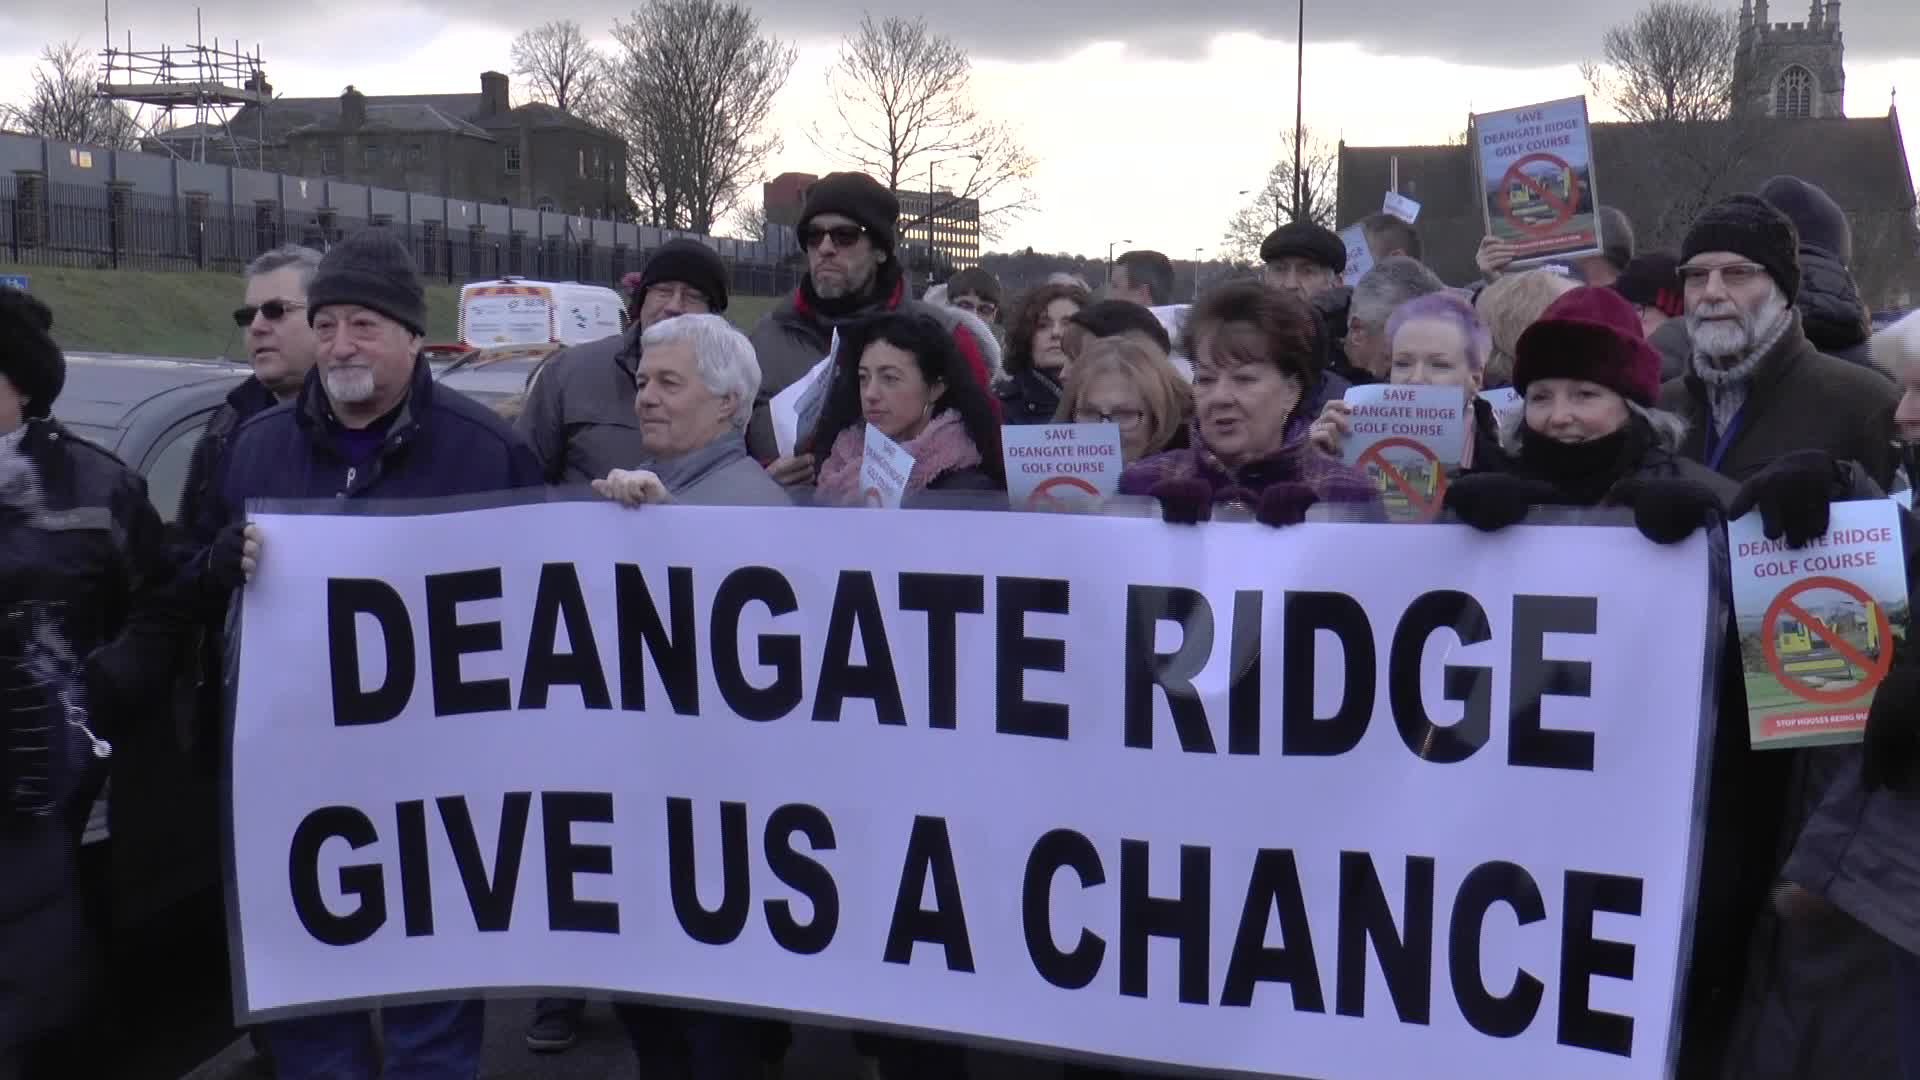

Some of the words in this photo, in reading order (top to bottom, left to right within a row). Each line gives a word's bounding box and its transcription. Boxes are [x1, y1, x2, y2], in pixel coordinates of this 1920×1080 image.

[1516, 111, 1544, 123] SAVE
[1483, 127, 1543, 145] DEANGATE
[1545, 119, 1578, 132] RIDGE
[1495, 144, 1523, 157] GOLF
[1526, 135, 1570, 151] COURSE
[1383, 389, 1416, 401] SAVE
[1352, 406, 1412, 418] EANGATE
[1416, 408, 1456, 419] RIDGE
[1044, 429, 1076, 440] SAVE
[1354, 422, 1387, 434] GOLF
[1392, 423, 1444, 437] COURSE
[1009, 446, 1074, 457] DEANGATE
[1077, 445, 1115, 456] RIDGE
[1022, 463, 1053, 473] GOLF
[1056, 462, 1104, 473] COURSE
[1833, 528, 1892, 545] RIDGE
[1754, 560, 1798, 578] GOLF
[1803, 552, 1877, 573] COURSE
[328, 562, 1070, 741] DEANGATE
[1124, 584, 1597, 772] RIDGE
[289, 791, 620, 946] GIVE
[666, 796, 839, 955] US
[883, 815, 976, 974] A
[1022, 828, 1643, 1058] CHANCE
